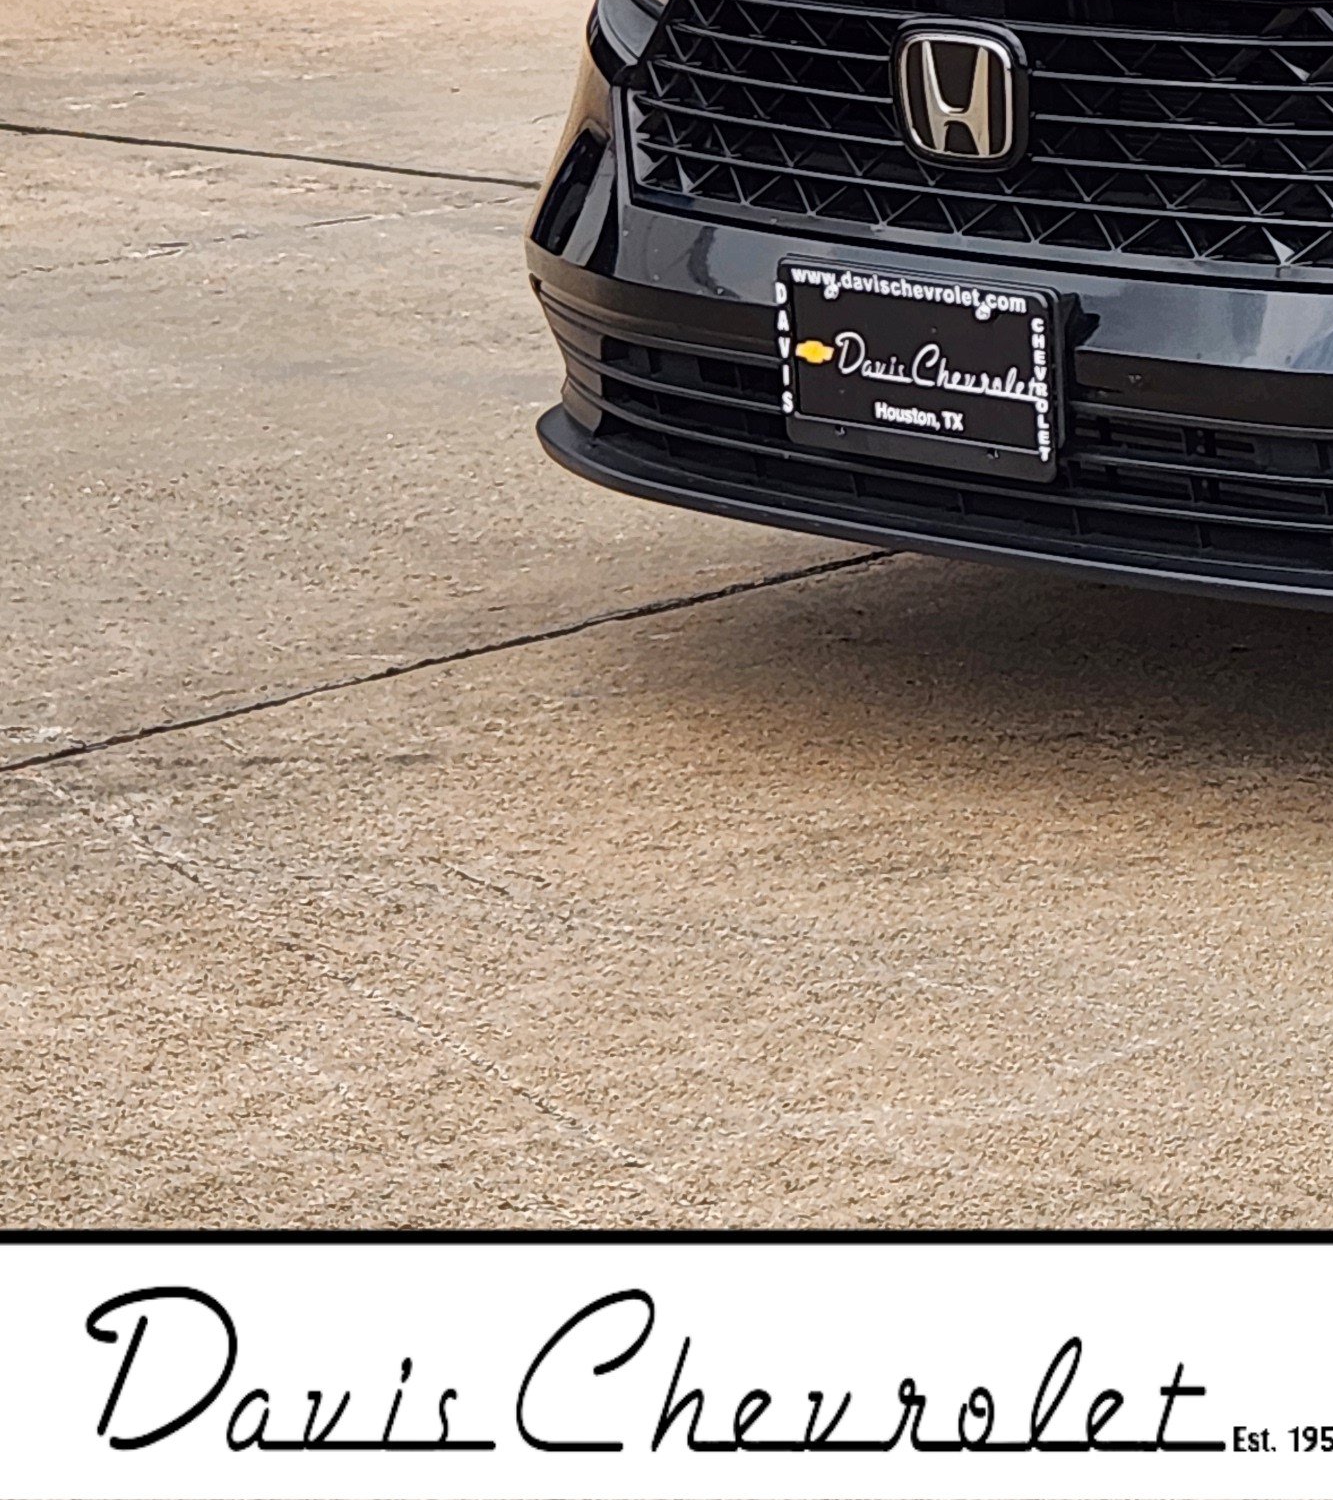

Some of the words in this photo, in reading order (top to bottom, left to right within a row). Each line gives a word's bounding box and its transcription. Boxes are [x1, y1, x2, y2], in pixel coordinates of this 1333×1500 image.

[791, 267, 1027, 314] www.davischevrolet.com
[775, 282, 794, 414] DAVIS
[835, 331, 913, 384] Davis
[912, 344, 1038, 402] Chevrolet
[874, 402, 940, 431] Houston,
[941, 411, 964, 432] TX
[1030, 317, 1052, 463] CHEVROLET
